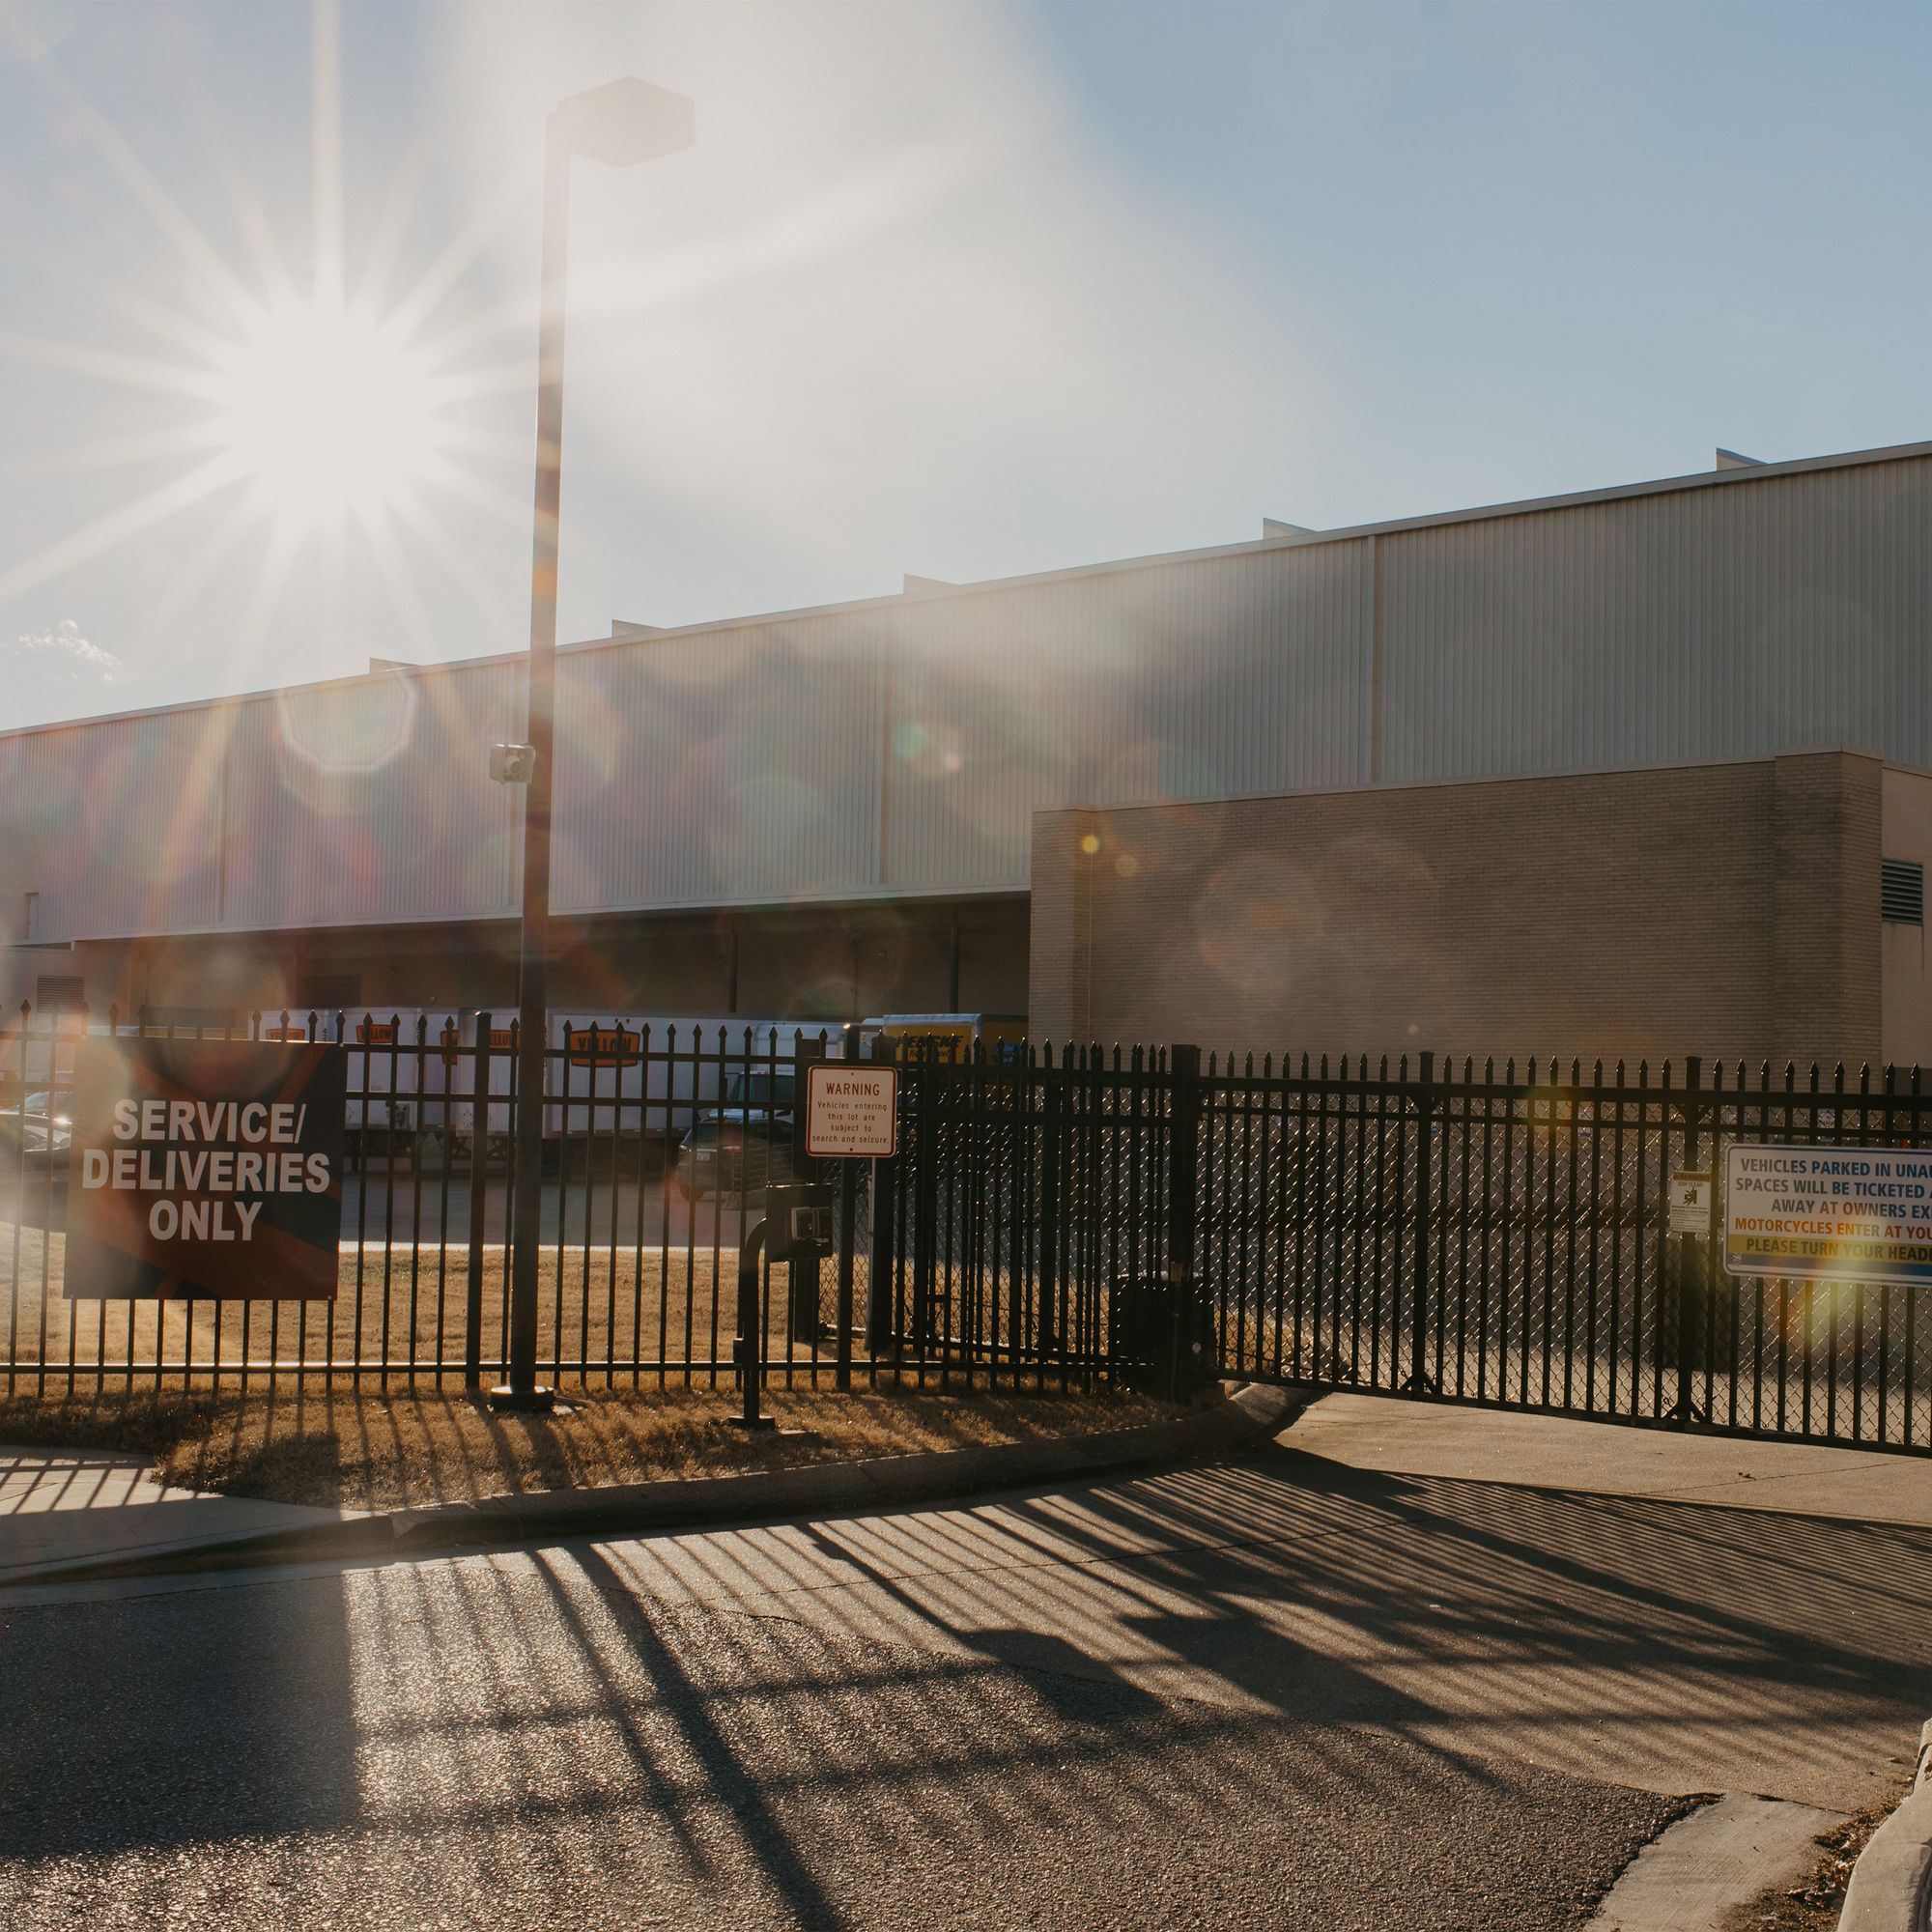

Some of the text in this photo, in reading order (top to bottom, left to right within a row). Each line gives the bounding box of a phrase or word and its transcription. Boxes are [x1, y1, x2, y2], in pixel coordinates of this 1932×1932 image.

[826, 1083, 880, 1095] WARNING
[112, 1099, 307, 1144] SERVICE/
[831, 1124, 859, 1133] subject
[82, 1149, 330, 1193] DELIVERIES
[1741, 1158, 1806, 1174] VEHICLES
[1812, 1161, 1870, 1176] PARKED
[1875, 1163, 1890, 1177] IN
[1736, 1178, 1788, 1193] SPACES
[1793, 1179, 1828, 1194] WILL
[1833, 1181, 1849, 1195] BE
[1854, 1182, 1925, 1199] TICKETED
[1771, 1199, 1932, 1219] AWAY AT OWNERS EX
[149, 1199, 263, 1241] ONLY
[1735, 1217, 1833, 1235] MOTORCYCLES
[1836, 1223, 1880, 1236] ENTER
[1885, 1225, 1902, 1238] AT
[1747, 1238, 1797, 1254] PLEASE
[1801, 1241, 1838, 1256] TURN
[1844, 1243, 1883, 1259] YOUR
